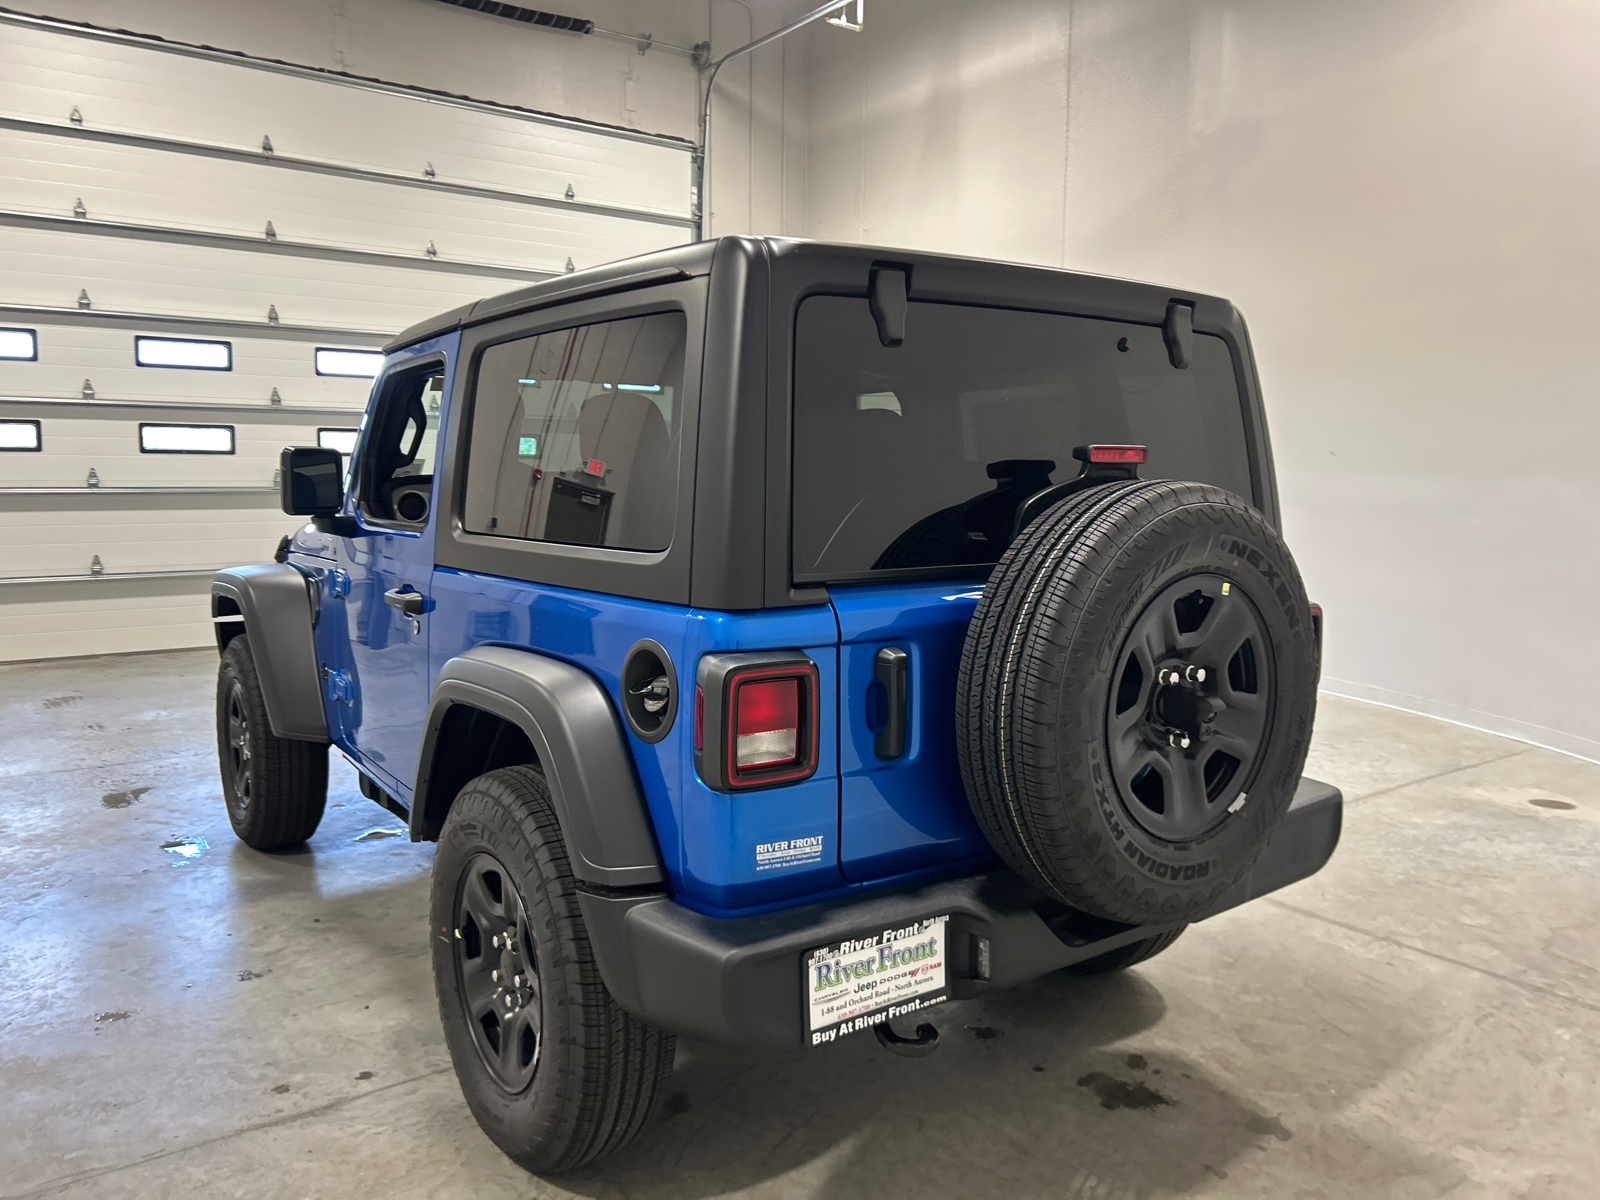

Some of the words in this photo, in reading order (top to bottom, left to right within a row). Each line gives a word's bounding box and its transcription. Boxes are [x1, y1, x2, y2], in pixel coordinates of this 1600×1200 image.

[1228, 540, 1300, 630] NEXEN
[756, 841, 788, 853] RIVER
[790, 836, 823, 849] FRONT
[1123, 841, 1210, 881] ROADIAN
[840, 935, 879, 955] River
[883, 922, 919, 943] Front
[814, 956, 876, 992] River
[876, 937, 937, 972] Front
[854, 980, 878, 994] Jeep
[880, 970, 913, 985] DODGE
[929, 962, 942, 970] RAM
[836, 1000, 848, 1012] and
[848, 992, 874, 1007] Orchard
[875, 986, 890, 998] Road
[894, 980, 912, 992] North
[914, 976, 934, 986] Aurora
[812, 1028, 837, 1045] Buy
[839, 1020, 854, 1036] At
[855, 1011, 888, 1031] River
[888, 995, 947, 1019] Front.com
